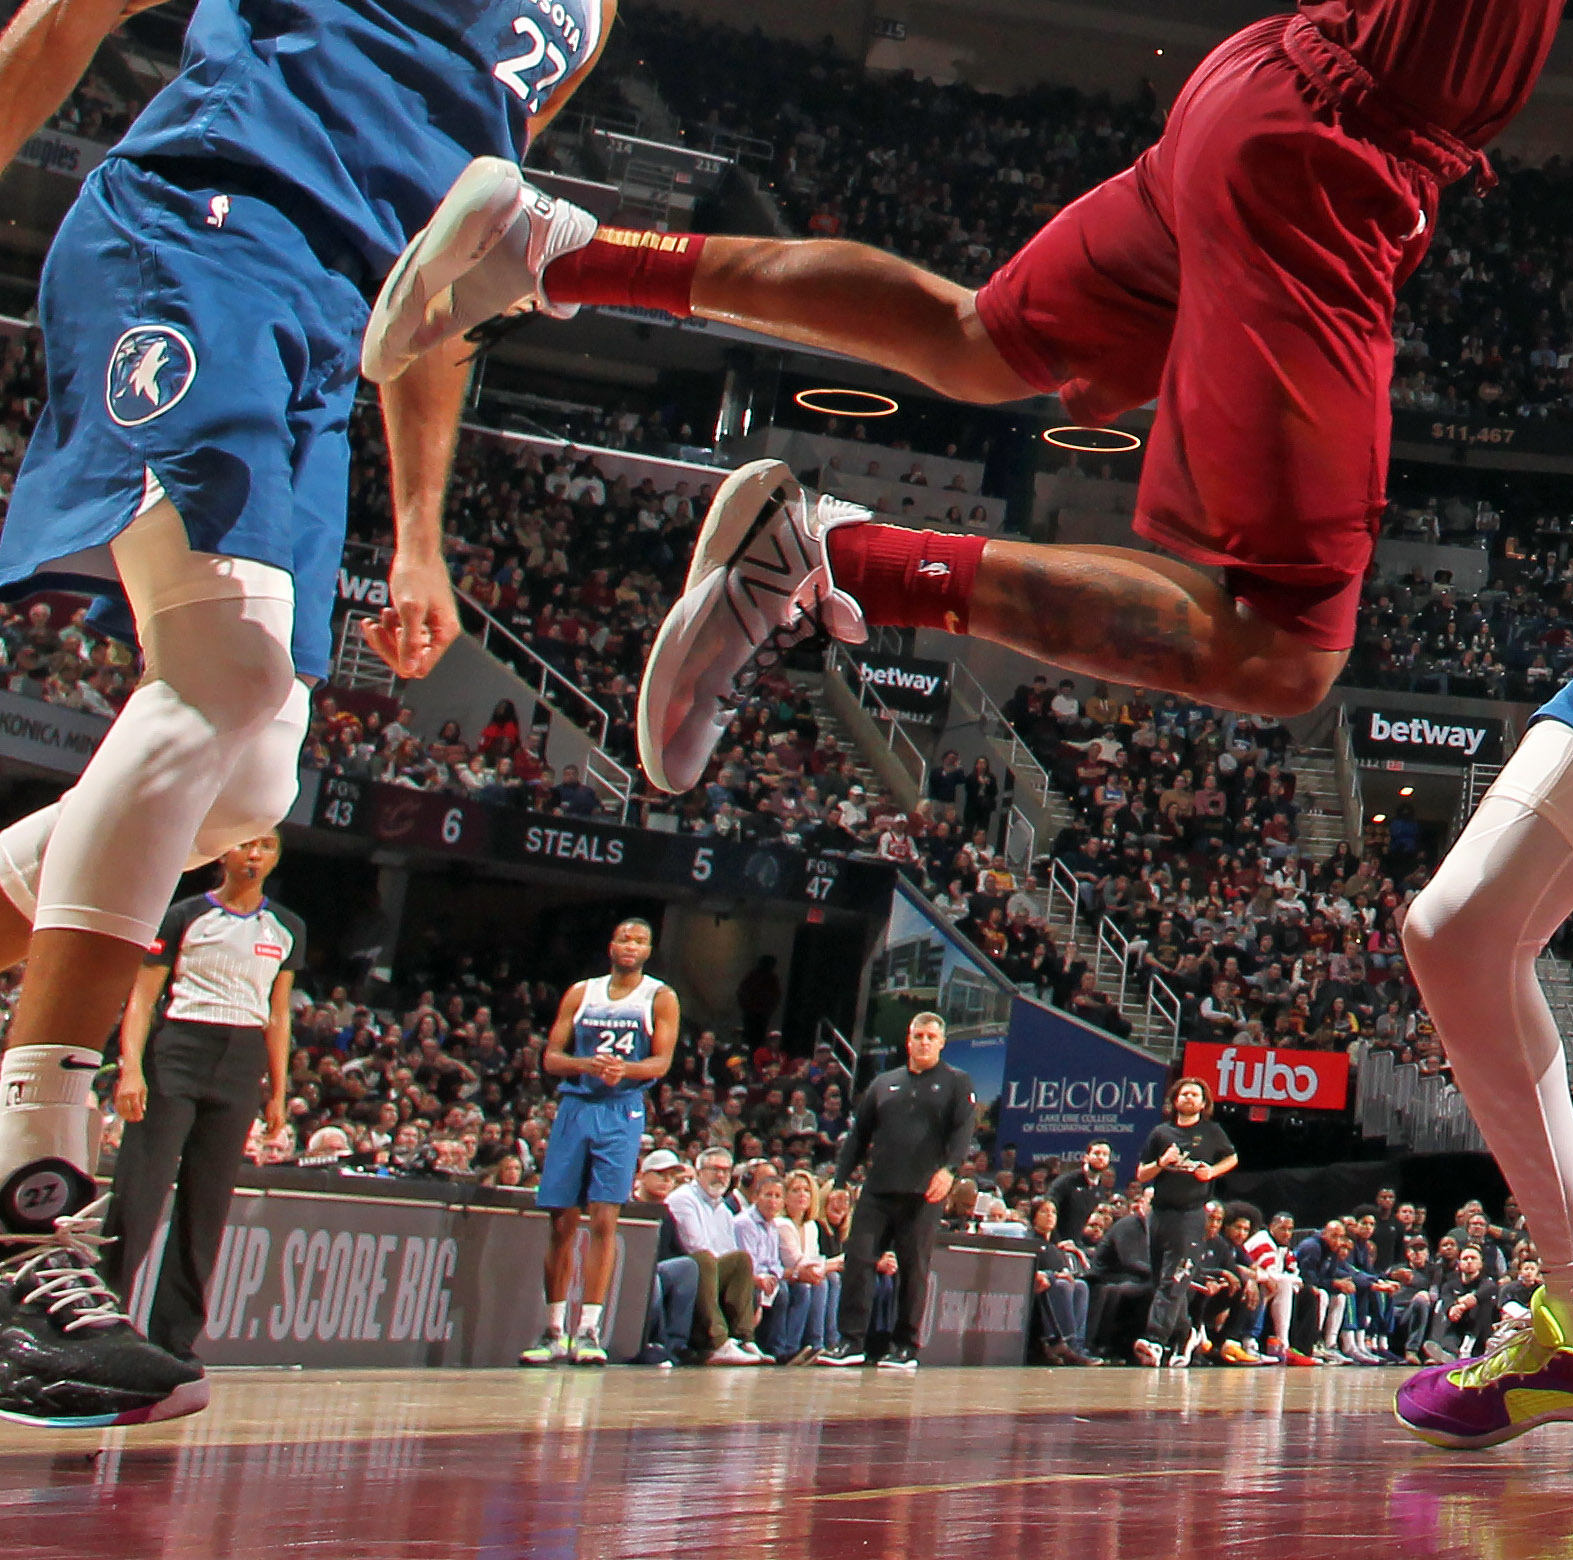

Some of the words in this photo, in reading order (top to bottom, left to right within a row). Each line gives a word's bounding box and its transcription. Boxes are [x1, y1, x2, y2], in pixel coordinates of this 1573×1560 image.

[1431, 422, 1516, 444] $11,467
[861, 662, 940, 696] betway
[1370, 712, 1487, 755] betway
[324, 800, 354, 827] 43
[442, 808, 463, 844] 6
[525, 827, 625, 866] STEALS
[692, 848, 715, 882] 5
[805, 877, 833, 901] 47
[595, 1030, 635, 1055] 24
[1216, 1047, 1319, 1102] fubo
[205, 1225, 271, 1340] UP.
[268, 1228, 398, 1340] SCORE
[390, 1234, 459, 1341] BIG.
